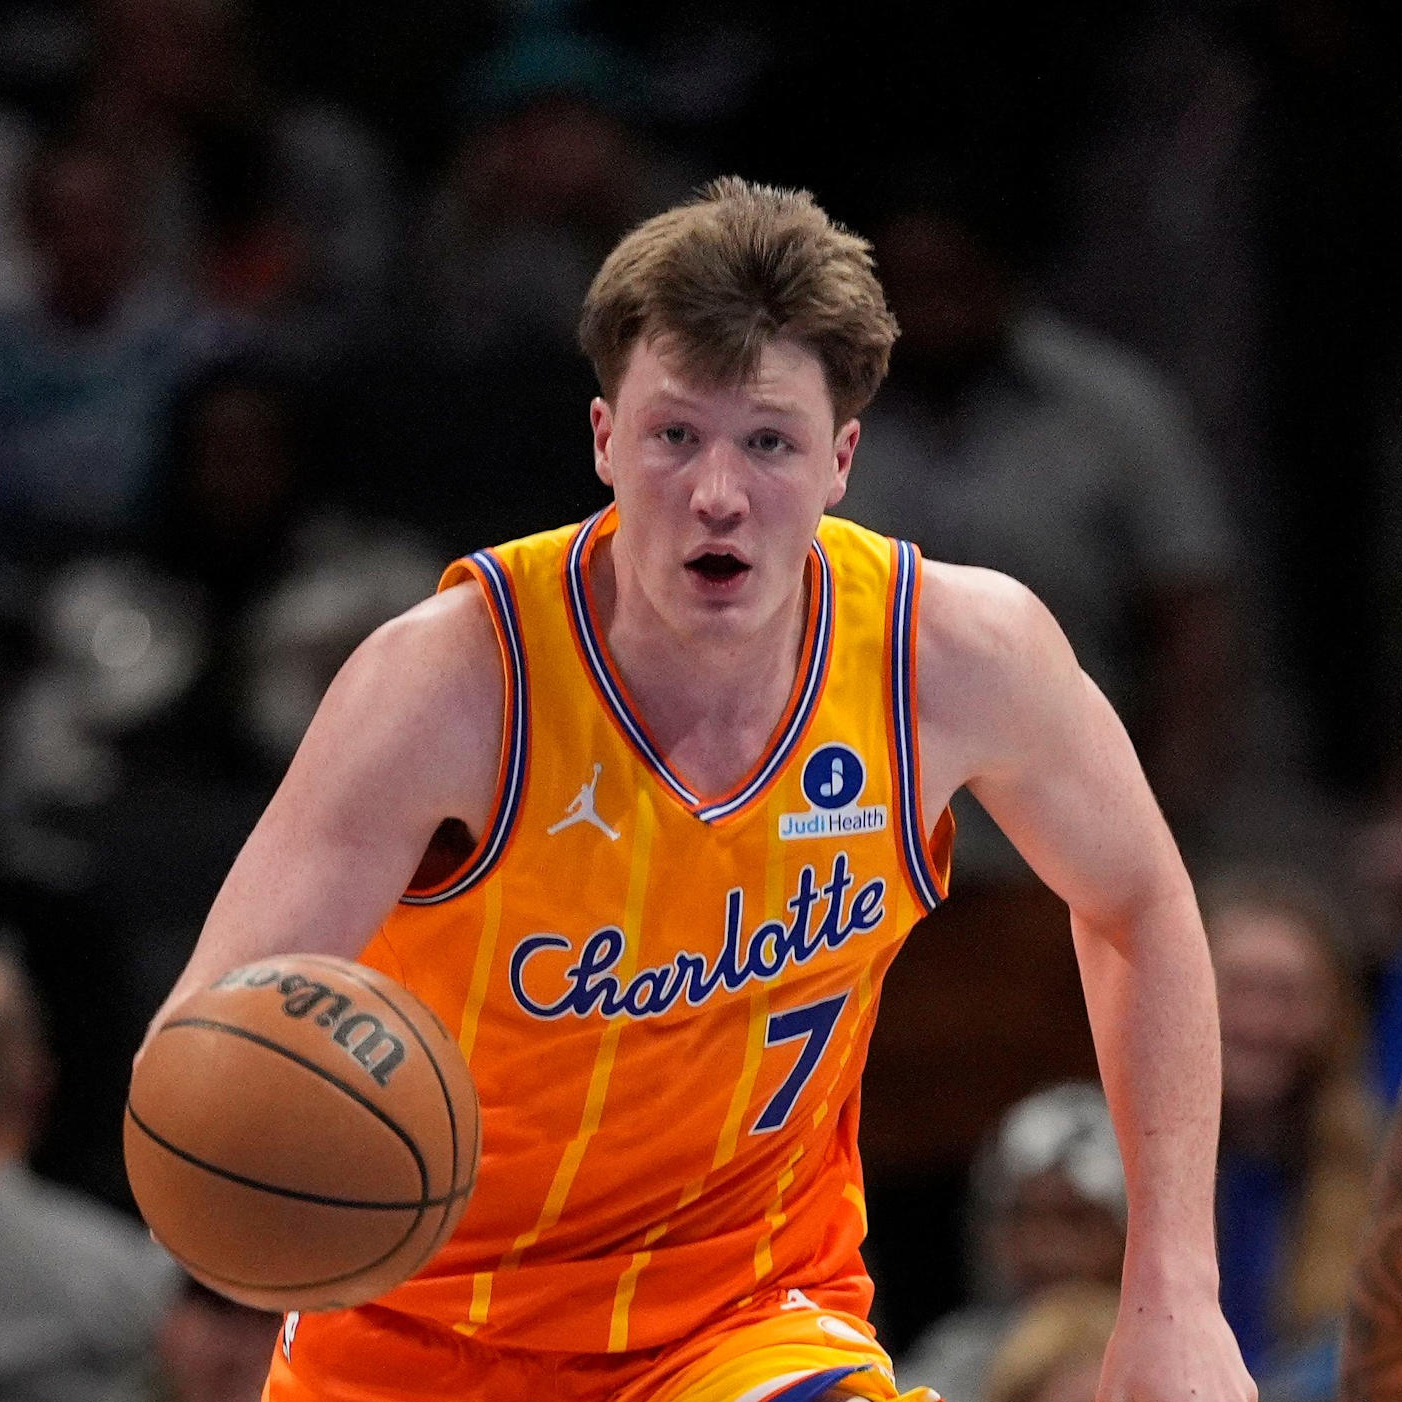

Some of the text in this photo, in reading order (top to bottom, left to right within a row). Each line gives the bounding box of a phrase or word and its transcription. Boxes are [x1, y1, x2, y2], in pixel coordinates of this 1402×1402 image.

[782, 808, 883, 836] Judi Health
[509, 850, 886, 1021] Charlotte
[748, 988, 853, 1135] 7
